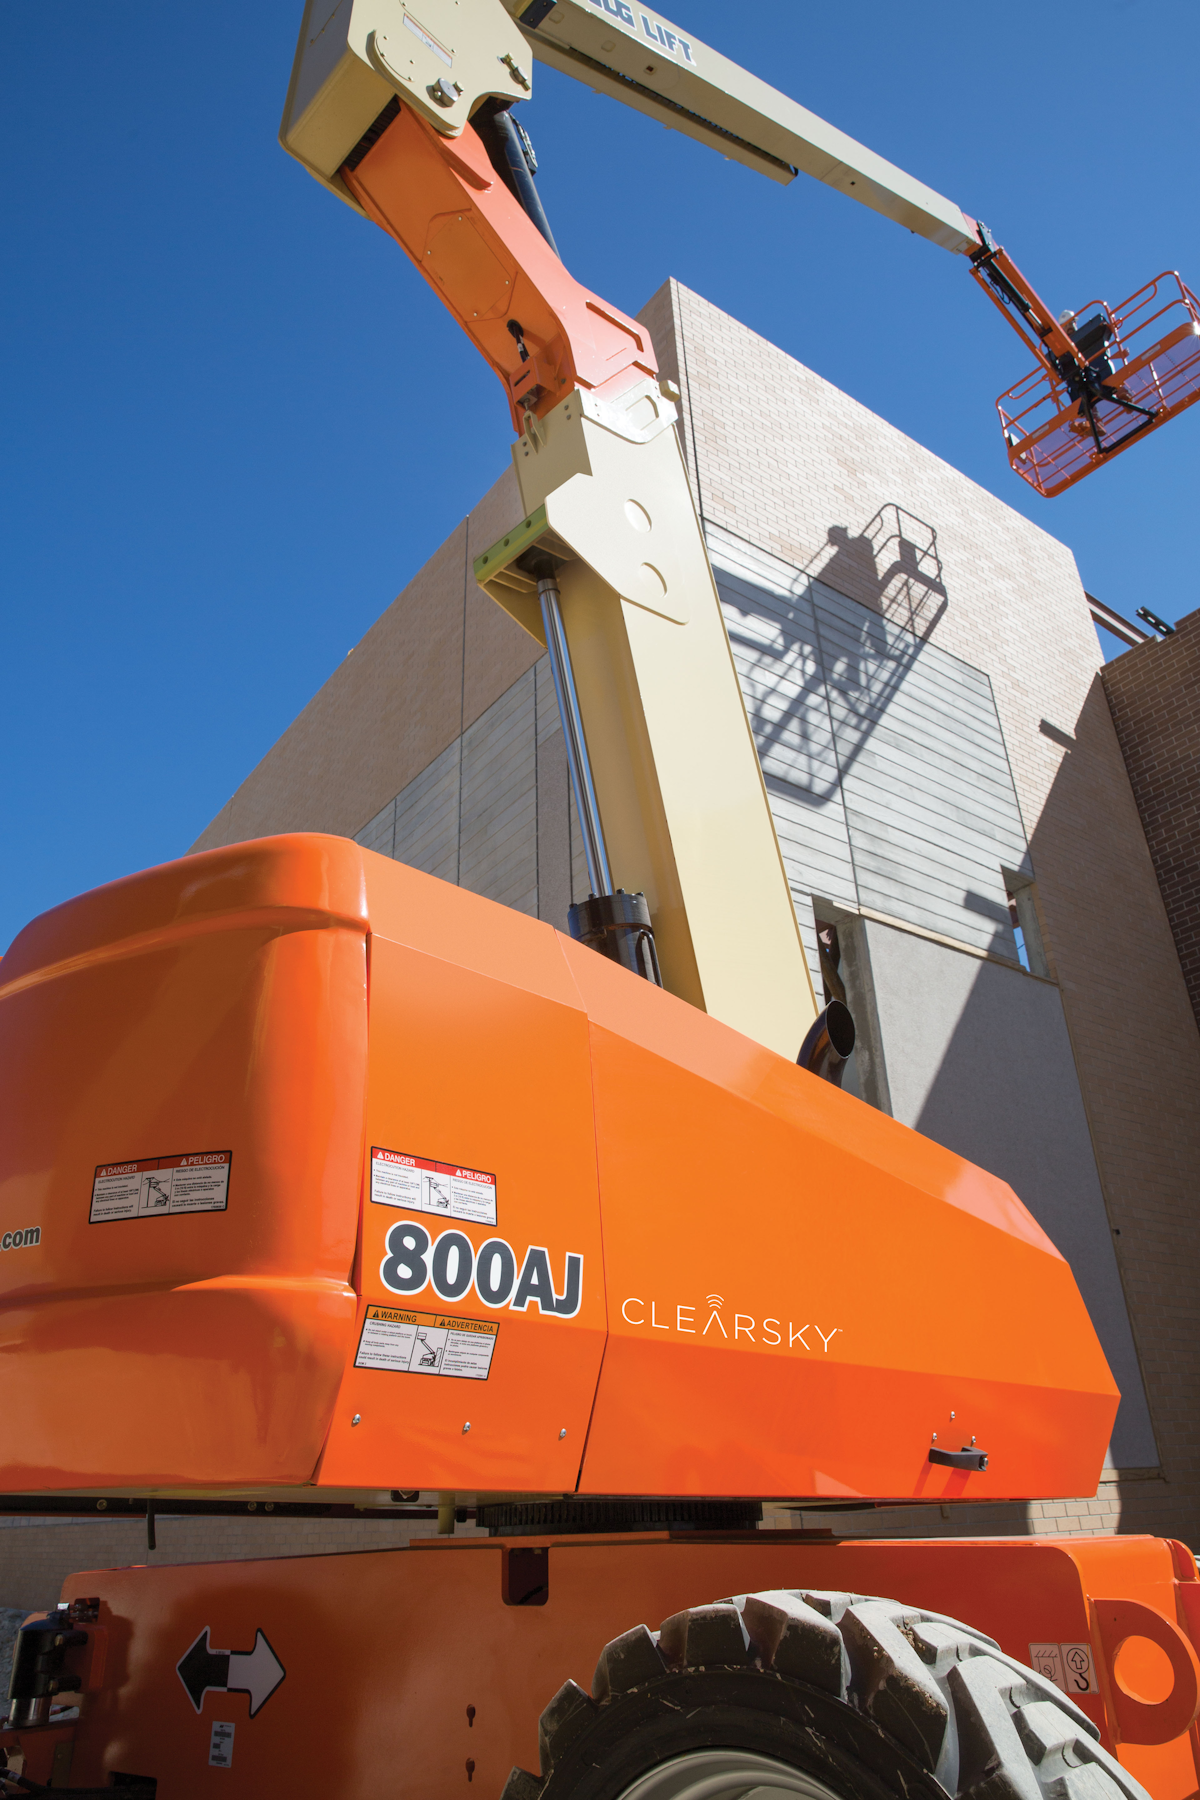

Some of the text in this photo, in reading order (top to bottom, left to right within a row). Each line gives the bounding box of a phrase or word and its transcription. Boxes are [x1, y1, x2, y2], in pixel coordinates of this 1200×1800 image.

[639, 11, 697, 66] LIFT
[188, 1154, 225, 1165] PELIGRO
[384, 1152, 416, 1166] DANGER
[107, 1164, 138, 1175] DANGER
[462, 1170, 491, 1183] PELIGRO
[0, 1226, 41, 1251] com
[379, 1220, 584, 1319] 800AJ
[381, 1310, 417, 1323] WARNING
[446, 1320, 494, 1333] ADVERTENCIA
[621, 1296, 838, 1353] CLEARSKY
